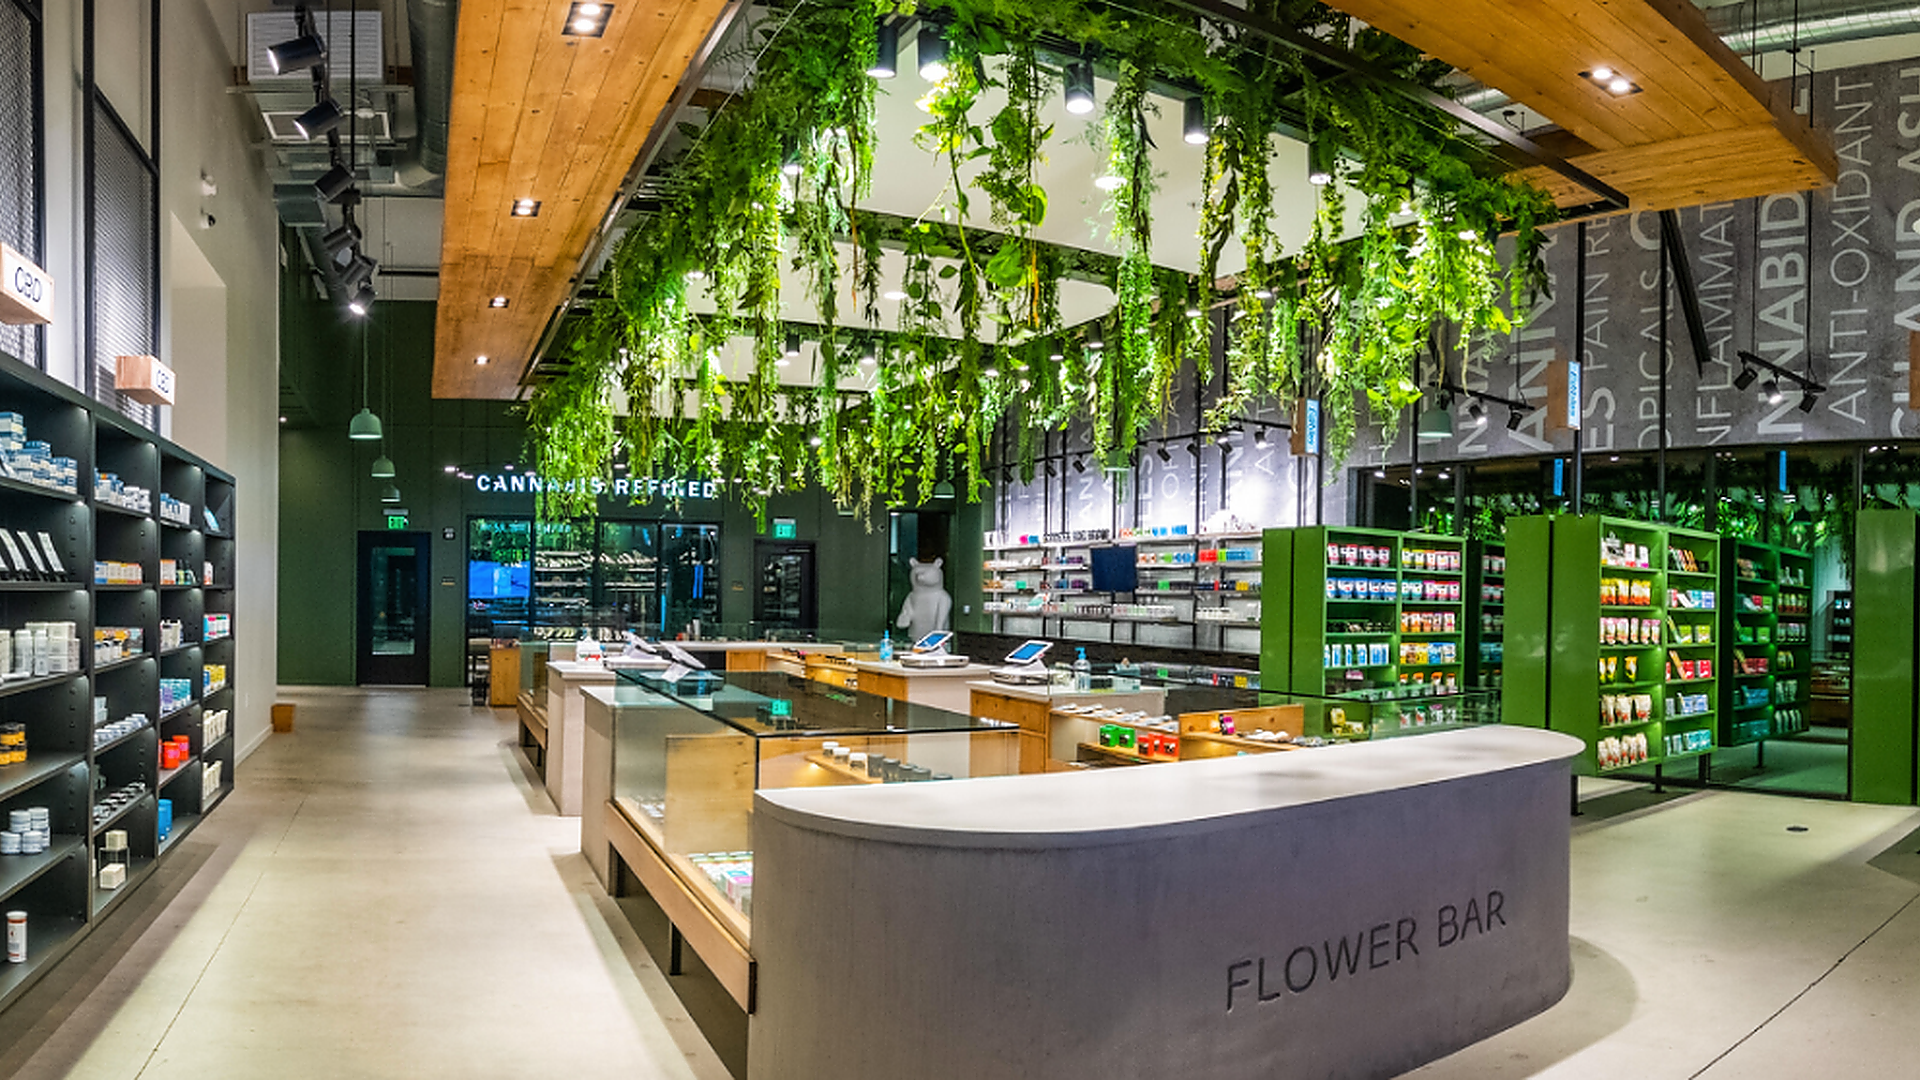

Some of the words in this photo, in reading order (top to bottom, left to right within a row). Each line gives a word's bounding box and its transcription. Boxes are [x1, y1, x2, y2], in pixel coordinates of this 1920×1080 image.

[14, 266, 44, 303] CBD
[1828, 75, 1874, 424] ANTI-OXIDANT
[1583, 272, 1610, 371] PAIN
[1757, 190, 1807, 436] NNABID
[476, 474, 602, 494] CANNABIS
[614, 478, 717, 499] REFINED
[1226, 917, 1420, 1012] FLOWER
[1437, 889, 1507, 948] BAR
